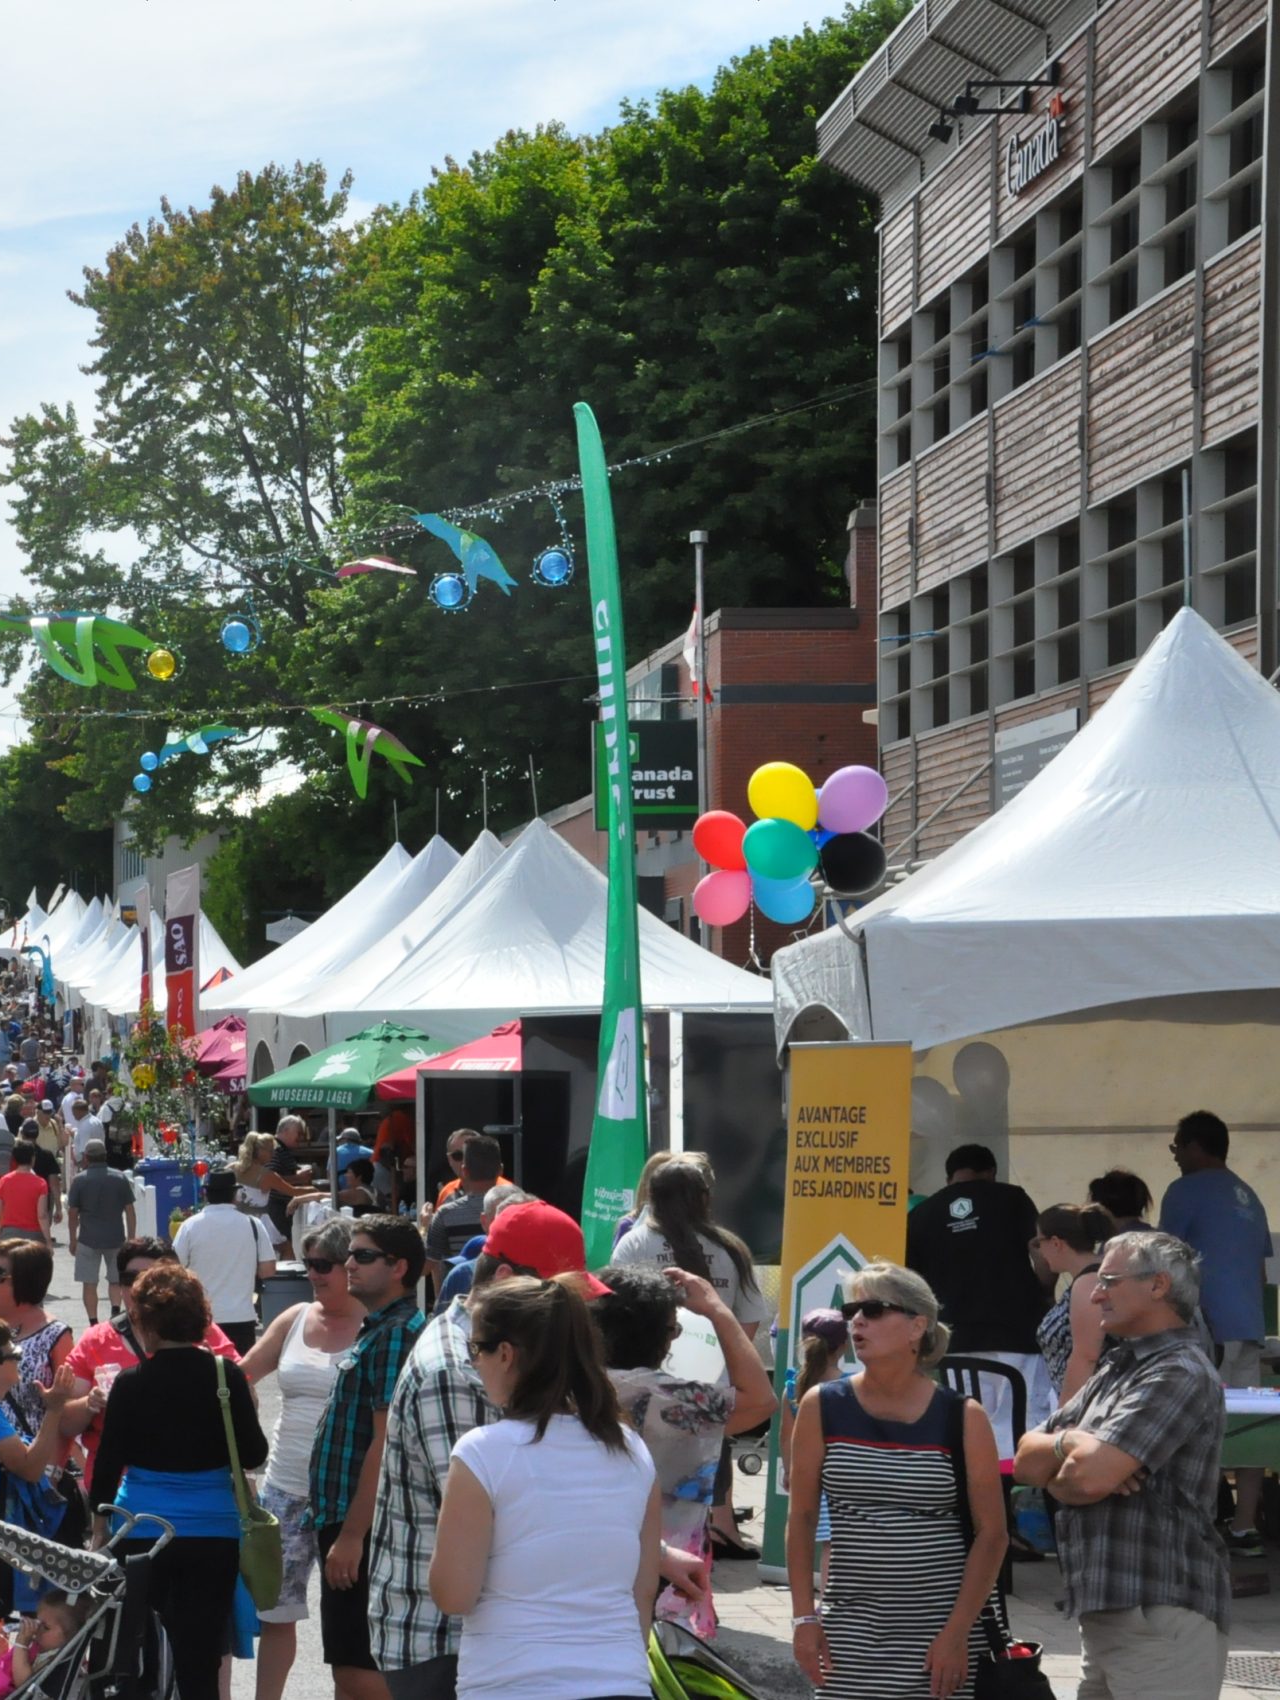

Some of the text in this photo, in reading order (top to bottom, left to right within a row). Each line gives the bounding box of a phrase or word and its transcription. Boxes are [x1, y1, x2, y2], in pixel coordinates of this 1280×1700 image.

[1006, 113, 1058, 198] Canada
[631, 766, 693, 781] anada
[631, 785, 675, 800] rust
[229, 1077, 247, 1092] SA
[271, 1089, 353, 1104] MOOSEHEAD LAGER
[797, 1106, 867, 1124] AVANTAGE
[796, 1131, 859, 1148] EXCLUSIF
[794, 1155, 891, 1174] AUX MEMBRES
[793, 1179, 898, 1200] DESJARDINS ICI
